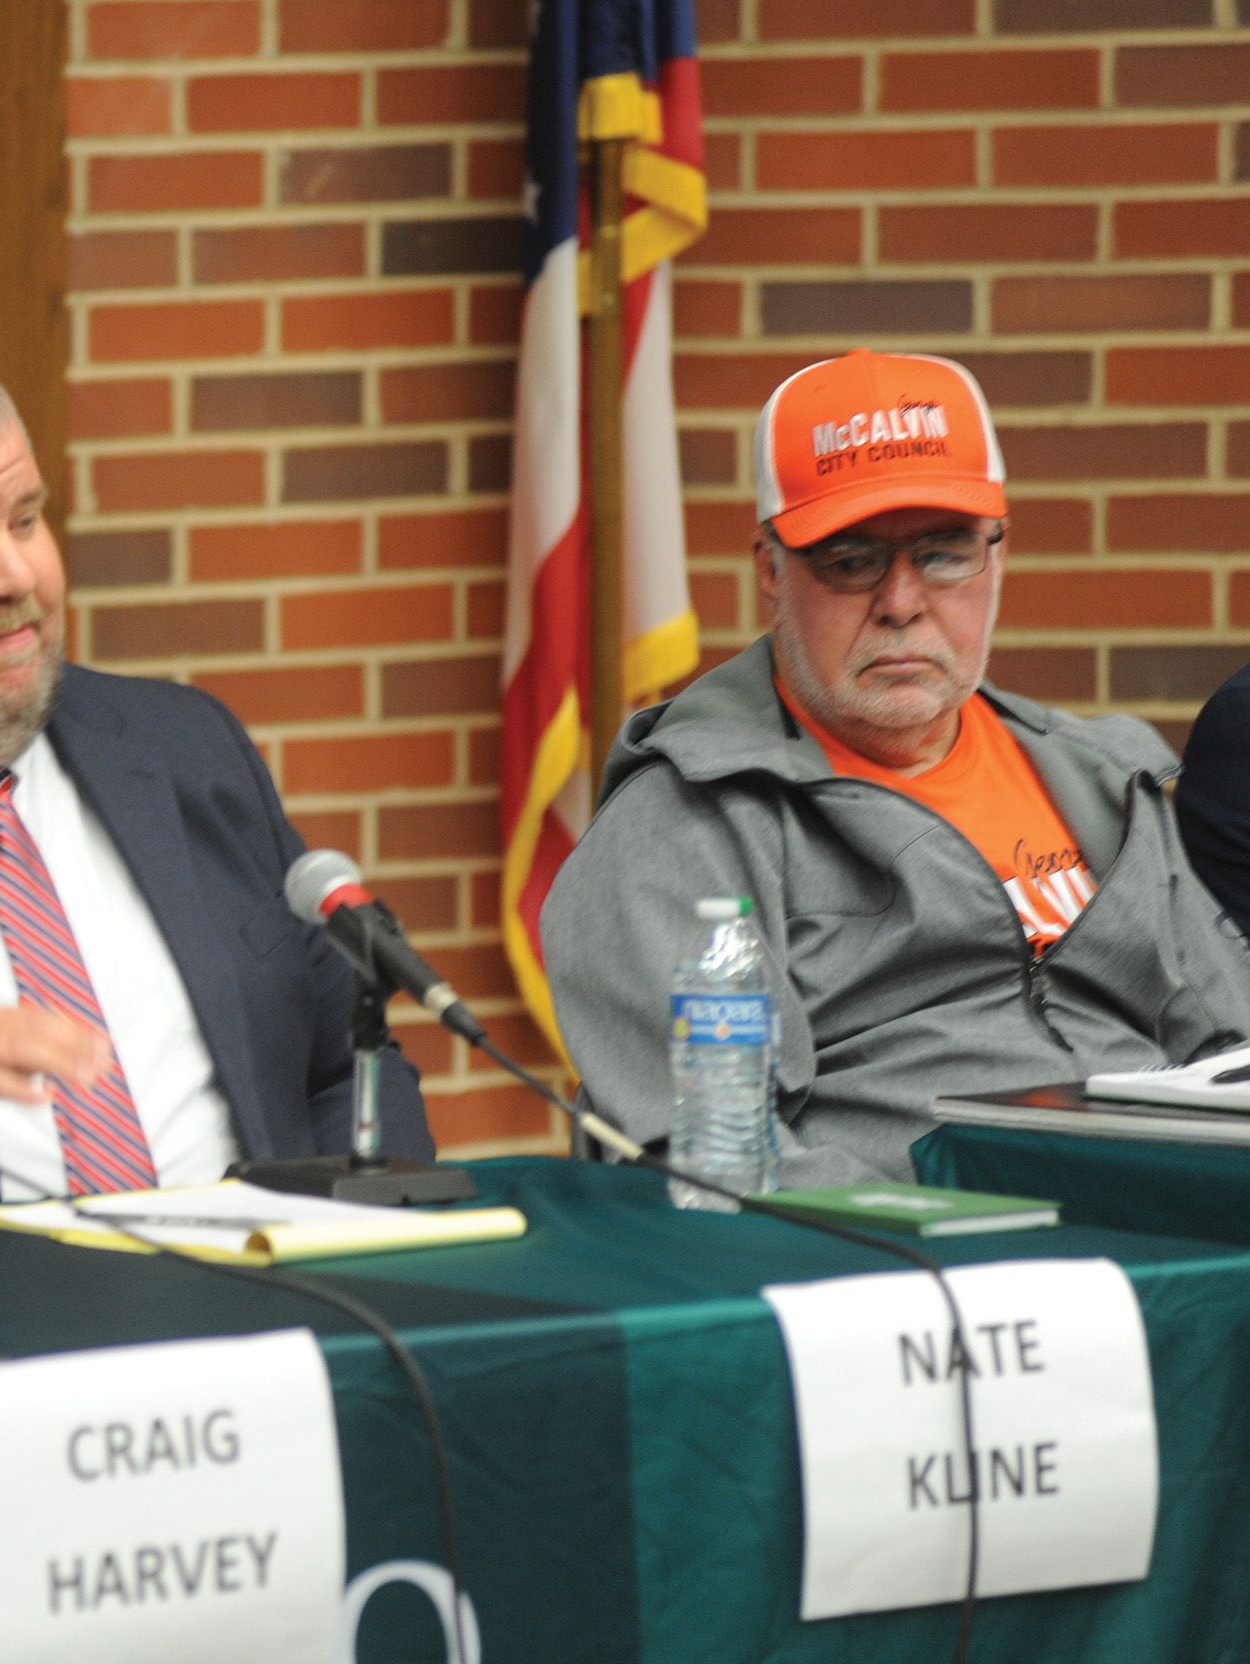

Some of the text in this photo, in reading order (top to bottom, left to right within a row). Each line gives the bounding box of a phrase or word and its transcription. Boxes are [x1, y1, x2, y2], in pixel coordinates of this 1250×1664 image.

[812, 405, 950, 458] McCALVIN
[816, 441, 950, 477] CITY COUNCIL
[897, 1319, 1046, 1388] NATE
[66, 1408, 242, 1483] CRAIG
[46, 1532, 279, 1615] HARVEY
